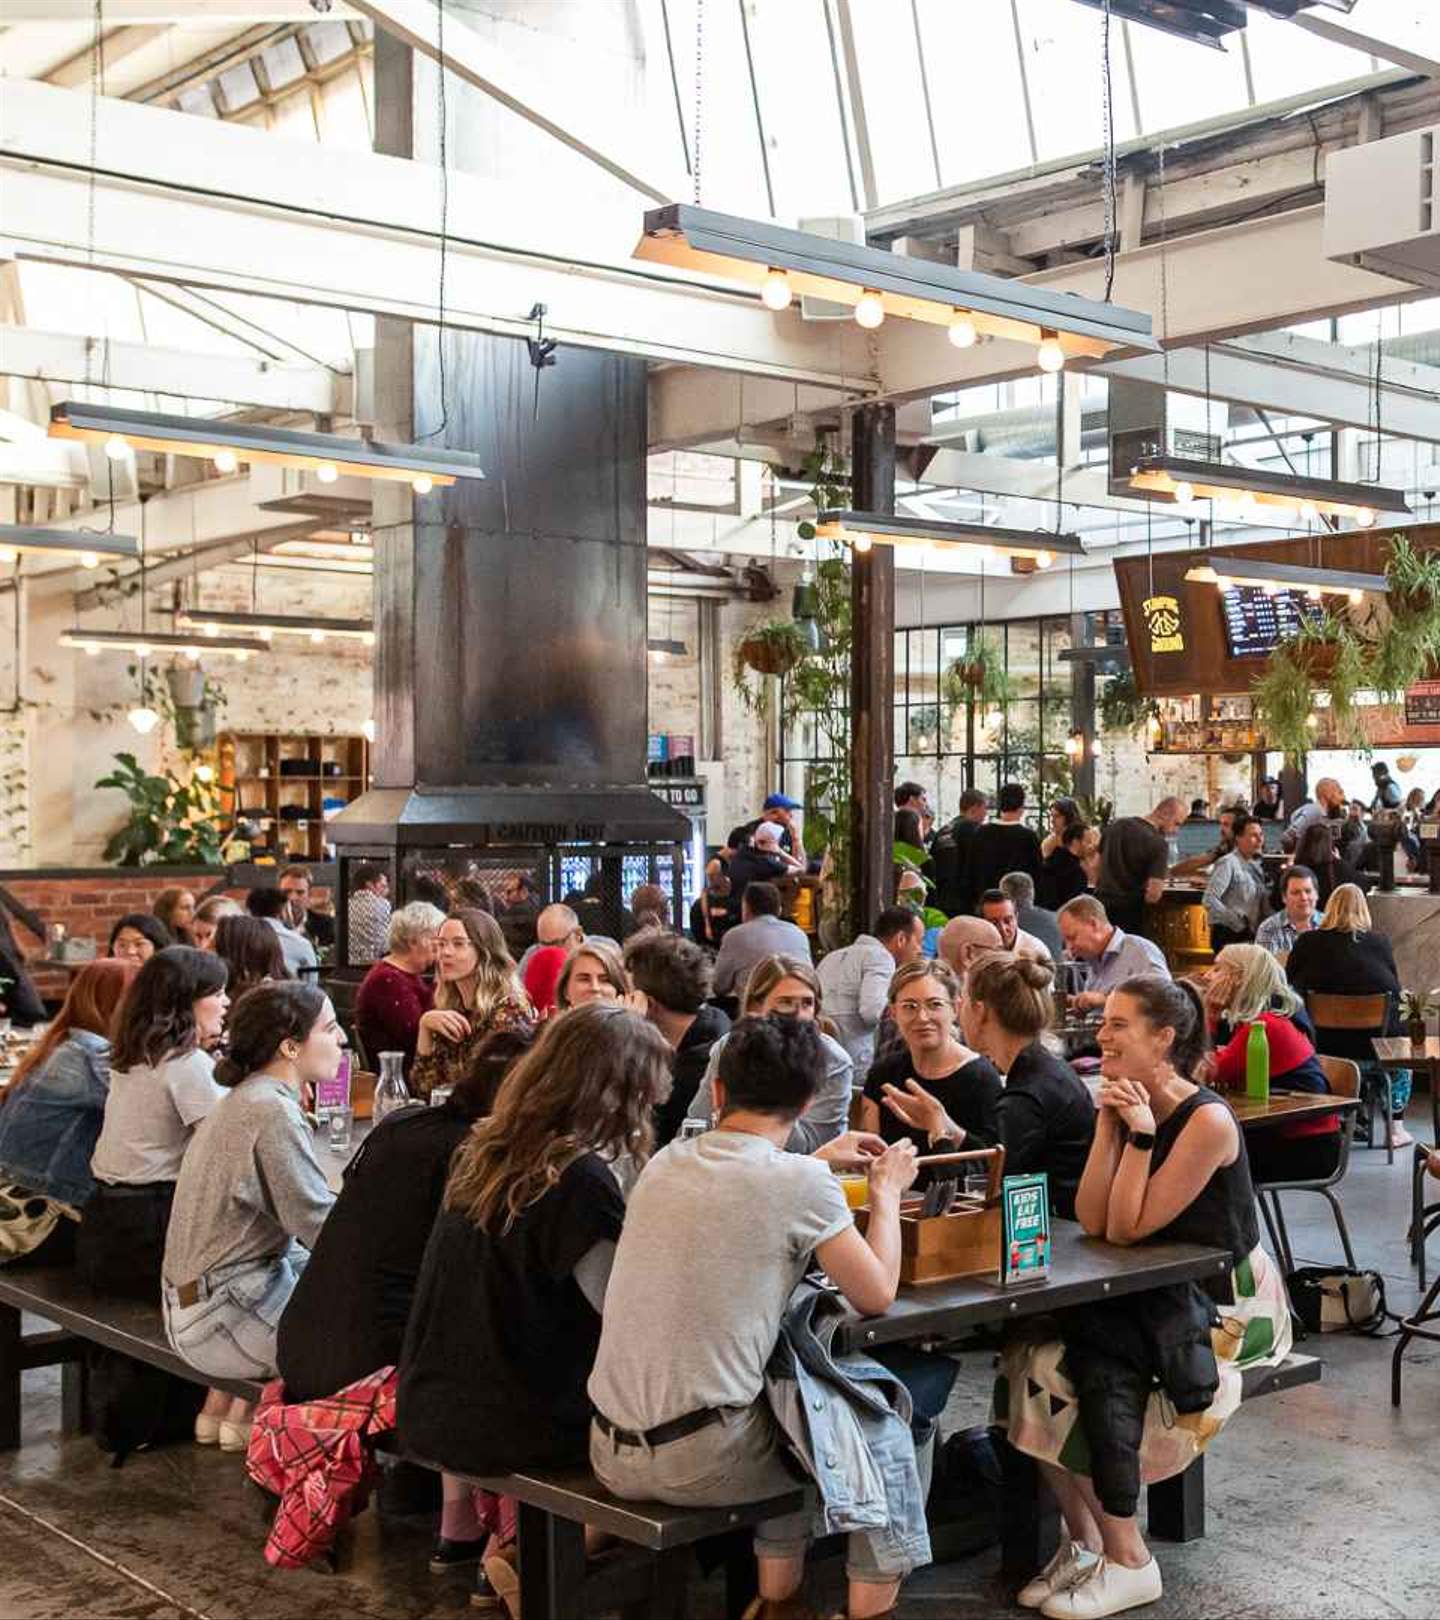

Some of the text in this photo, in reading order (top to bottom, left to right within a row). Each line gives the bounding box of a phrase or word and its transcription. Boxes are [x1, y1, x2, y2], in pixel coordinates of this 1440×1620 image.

[670, 789, 682, 803] TO
[684, 788, 698, 803] GO
[1013, 1191, 1039, 1206] KIDS
[1017, 1203, 1037, 1218] EAT
[1014, 1214, 1040, 1231] FREE
